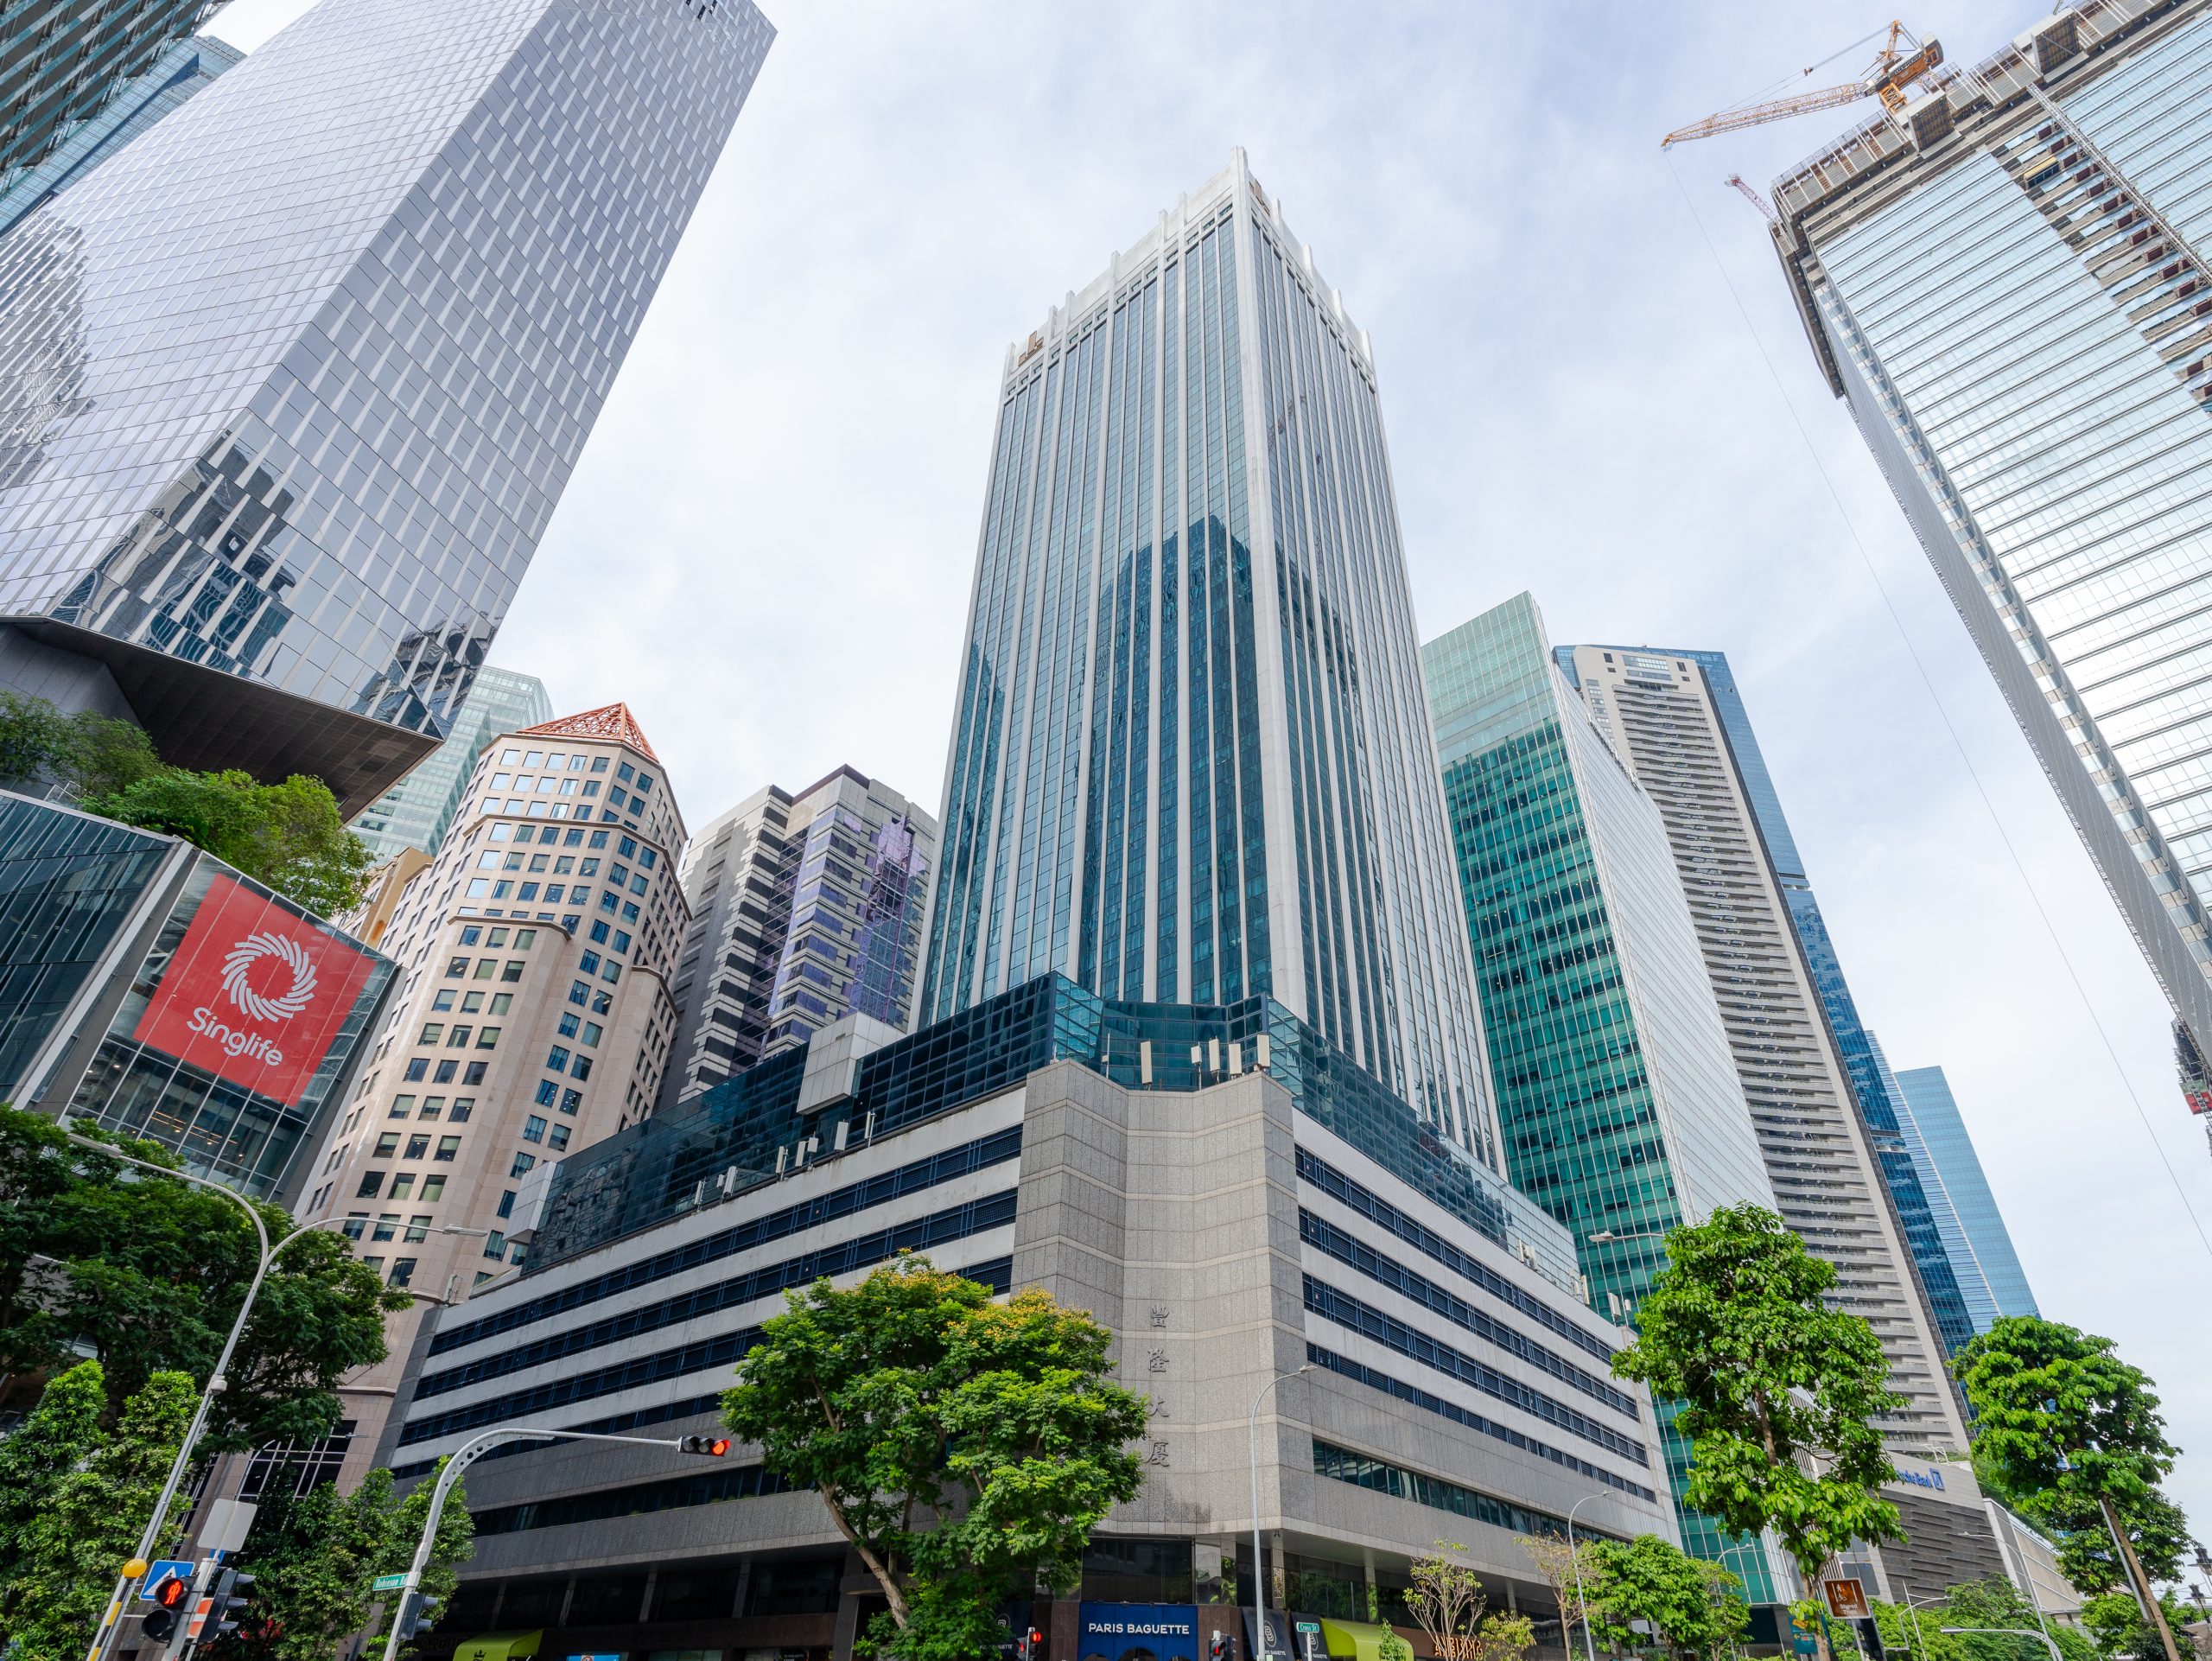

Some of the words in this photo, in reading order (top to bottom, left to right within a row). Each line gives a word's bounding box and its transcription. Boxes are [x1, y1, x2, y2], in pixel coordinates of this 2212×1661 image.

[187, 1007, 283, 1066] Singlife
[376, 1578, 398, 1588] Robinson
[1089, 1623, 1123, 1633] PARIS
[1127, 1624, 1190, 1635] BAGUETTE
